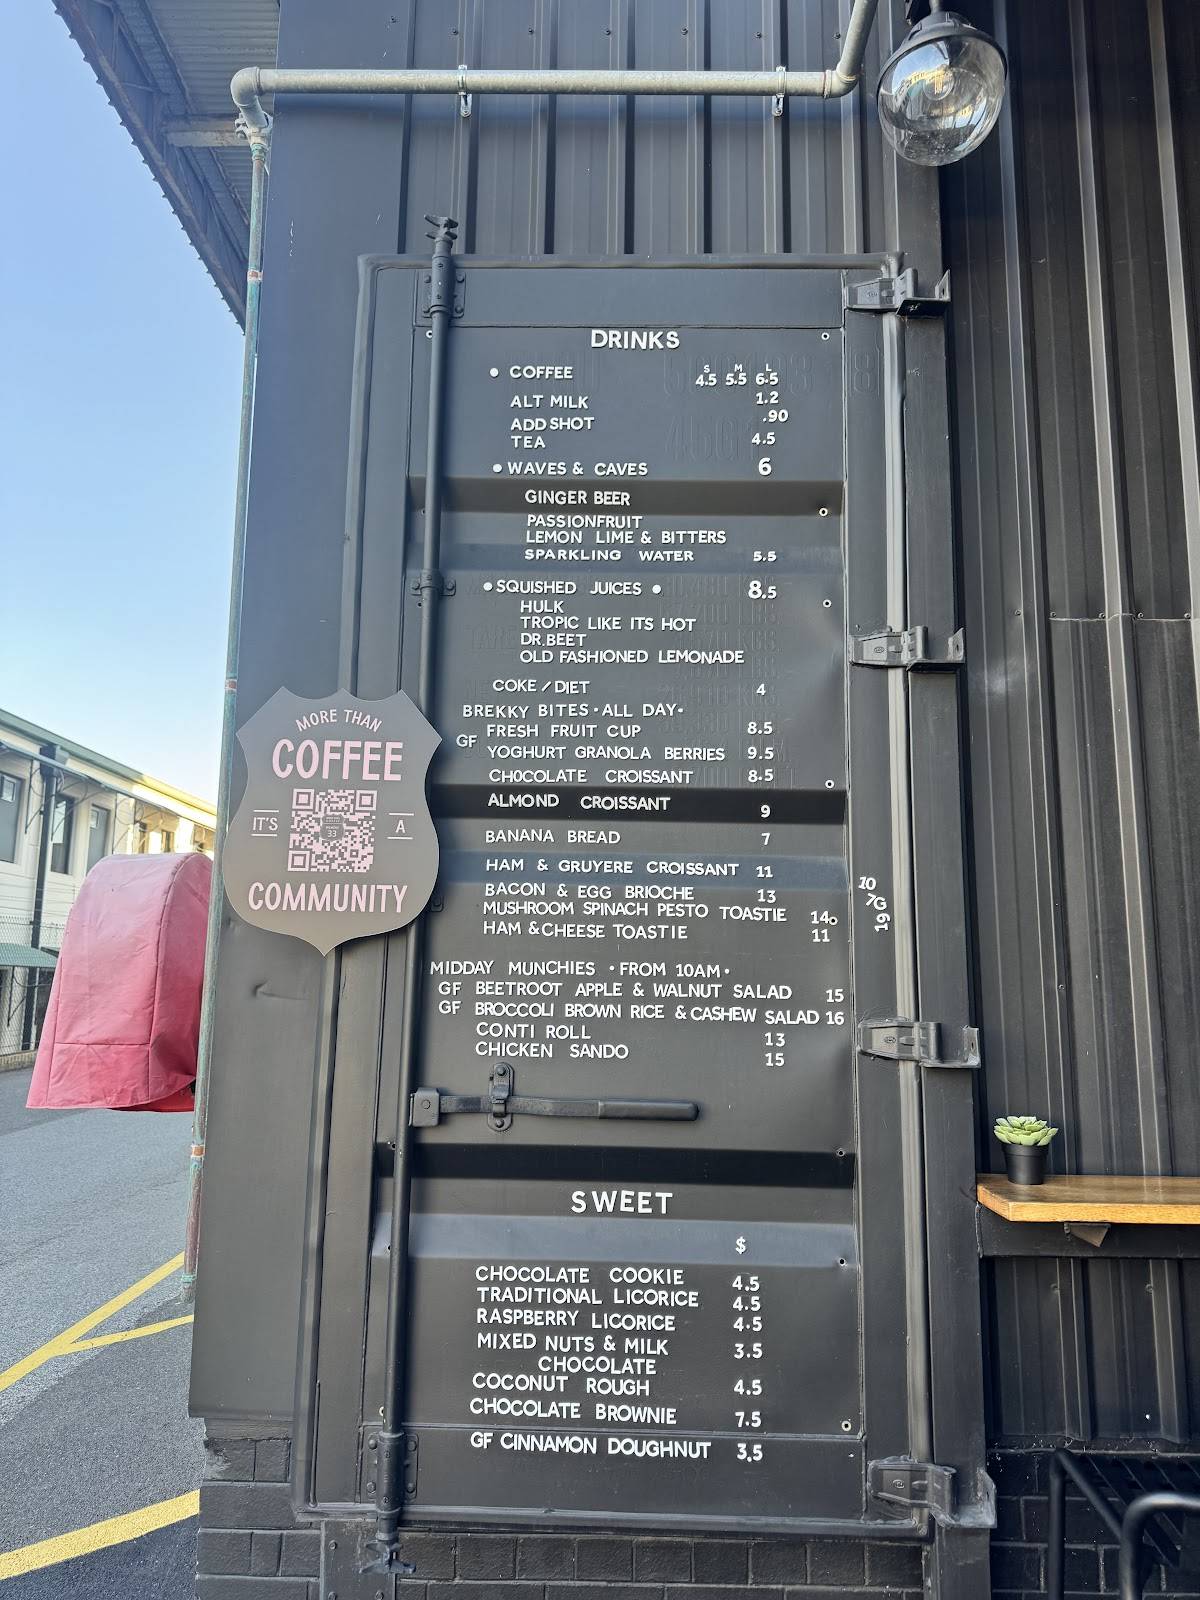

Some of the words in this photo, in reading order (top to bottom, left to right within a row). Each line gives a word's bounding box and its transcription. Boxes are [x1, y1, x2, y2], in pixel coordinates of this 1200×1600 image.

[591, 329, 679, 349] DRINKS
[510, 366, 573, 378] COFFEE
[696, 372, 717, 386] 4.5
[726, 371, 747, 385] 5.5
[756, 372, 778, 385] 6.5
[704, 365, 710, 373] S
[734, 364, 742, 372] M
[510, 395, 543, 408] ALT
[550, 395, 588, 408] MILK
[756, 391, 778, 404] 1.2
[511, 418, 546, 431] ADD
[550, 417, 594, 430] SHOT
[763, 409, 788, 422] .90
[511, 436, 545, 448] TEA
[752, 432, 775, 445] 4.5
[508, 462, 566, 475] WAVES
[573, 462, 583, 474] &
[594, 463, 647, 475] CAVES
[759, 458, 771, 475] 6
[525, 489, 587, 504] GINGER
[594, 491, 630, 505] BEER
[527, 514, 642, 528] PASSIONFRUIT
[526, 530, 582, 543] LEMON
[596, 531, 634, 543] LIME
[641, 531, 651, 543] &
[662, 530, 726, 543] BITTERS
[525, 549, 621, 560] SPARKLING
[639, 551, 694, 561] WATER
[753, 551, 776, 561] 5.5
[496, 579, 576, 594] SQUISHED
[590, 582, 641, 595] JUICES
[748, 580, 776, 599] 8.5
[521, 600, 563, 613] HULK
[520, 616, 579, 629] TROPIC
[588, 617, 621, 630] LIKE
[631, 617, 653, 630] ITS
[662, 618, 696, 631] HOT
[520, 650, 553, 663] OLD
[560, 649, 648, 663] FASHIONED
[659, 650, 744, 664] LEMONADE
[756, 684, 766, 695] 4
[296, 709, 337, 731] MORE
[344, 710, 382, 732] THAN
[463, 705, 529, 718] BREKKY
[487, 724, 538, 738] FRESH
[551, 724, 597, 737] FRUIT
[607, 725, 641, 738] CUP
[747, 722, 772, 734] 8.5
[456, 734, 477, 747] GF
[273, 739, 403, 780] COFFEE
[487, 745, 566, 759] YOGHURT
[575, 746, 651, 759] GRANOLA
[665, 747, 725, 761] BERRIES
[748, 747, 774, 759] 9.5
[605, 770, 693, 783] CROISSANT
[748, 769, 773, 782] 8.5
[488, 793, 559, 807] ALMOND
[581, 796, 670, 810] CROISSANT
[761, 805, 770, 818] 9
[396, 820, 405, 833] A
[486, 829, 554, 843] BANANA
[568, 830, 620, 843] BREAD
[762, 833, 770, 845] 7
[486, 859, 523, 871] HAM
[537, 859, 548, 871] &
[558, 860, 633, 873] GRUYERE
[647, 861, 739, 876] CROISSANT
[756, 866, 773, 877] 11
[485, 882, 545, 896] BACON
[557, 883, 568, 897] &
[578, 885, 611, 899] EGG
[625, 885, 694, 900] BRIOCHE
[758, 889, 776, 903] 13
[859, 877, 876, 890] 10
[249, 882, 407, 913] COMMUNITY
[484, 901, 574, 915] MUSHROOM
[583, 902, 648, 916] SPINACH
[658, 903, 708, 918] PESTO
[719, 906, 787, 921] TOASTIE
[484, 921, 521, 935] HAM
[528, 921, 540, 934] &
[613, 924, 687, 939] TOASTIE
[812, 929, 830, 942] 11
[431, 960, 494, 975] MIDDAY
[509, 961, 595, 975] MUNCHIES
[439, 981, 461, 995] GF
[476, 981, 563, 996] BEETROOT
[575, 982, 622, 997] APPLE
[633, 982, 644, 996] &
[653, 983, 722, 998] WALNUT
[733, 984, 792, 999] SALAD
[826, 989, 844, 1002] 15
[439, 1000, 461, 1014] GF
[475, 1002, 554, 1017] BROCCOLI
[565, 1003, 621, 1018] BROWN
[631, 1005, 664, 1018] RICE
[675, 1005, 687, 1019] &
[765, 1010, 819, 1024] SALAD
[826, 1011, 844, 1025] 16
[476, 1022, 534, 1038] CONTI
[546, 1025, 591, 1039] ROLL
[765, 1032, 785, 1047] 13
[475, 1041, 552, 1057] CHICKEN
[570, 1044, 628, 1059] SANDO
[765, 1053, 784, 1066] 15
[571, 1190, 673, 1214] SWEET
[736, 1236, 746, 1254] $
[476, 1266, 589, 1283] CHOCOLATE
[609, 1267, 683, 1285] COOKIE
[732, 1276, 759, 1291] 4.5
[477, 1287, 602, 1304] TRADITIONAL
[614, 1288, 698, 1307] LICORICE
[733, 1296, 760, 1311] 4.5
[477, 1308, 579, 1326] RASPBERRY
[592, 1313, 675, 1331] LICORICE
[734, 1317, 762, 1331] 4.5
[478, 1333, 536, 1349] MIXED
[546, 1336, 594, 1352] NUTS
[604, 1335, 616, 1351] &
[625, 1338, 668, 1355] MILK
[734, 1343, 762, 1359] 3.5
[538, 1356, 656, 1376] CHOCOLATE
[473, 1373, 568, 1392] COCONUT
[587, 1378, 649, 1396] ROUGH
[734, 1379, 762, 1395] 4.5
[470, 1398, 580, 1418] CHOCOLATE
[596, 1403, 676, 1424] BROWNIE
[735, 1411, 761, 1427] 7.5
[471, 1432, 493, 1448] GF
[500, 1432, 597, 1454] CINNAMON
[608, 1436, 711, 1458] DOUGHNUT
[737, 1443, 762, 1462] 3.5
